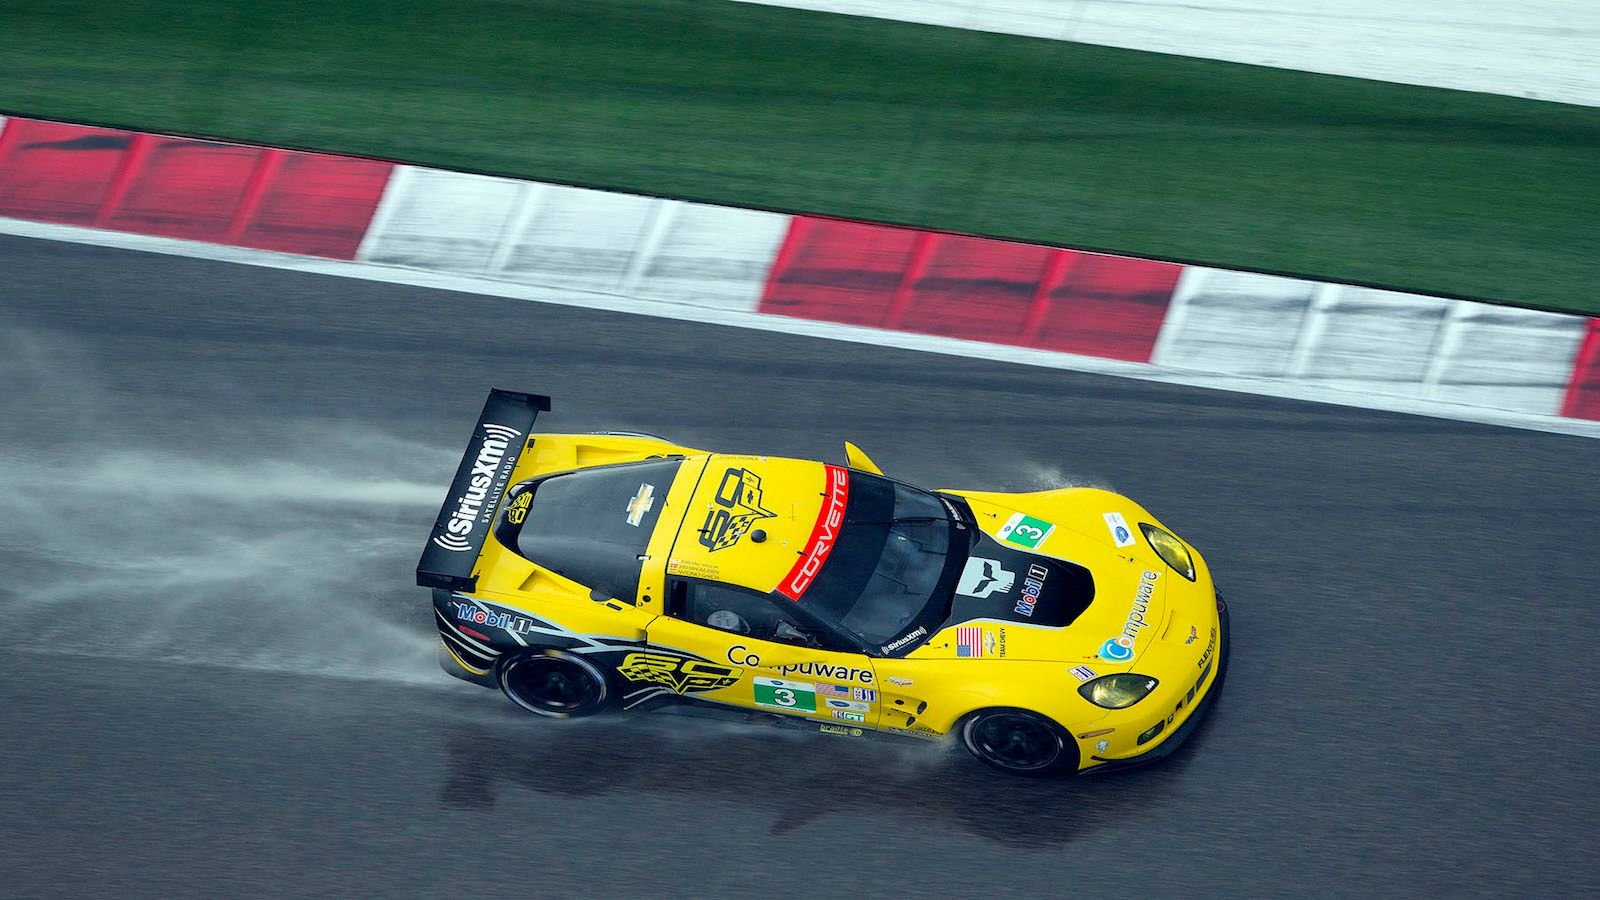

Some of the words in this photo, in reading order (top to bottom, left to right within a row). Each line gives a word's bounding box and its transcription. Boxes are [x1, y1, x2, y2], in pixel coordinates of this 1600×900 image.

[481, 482, 505, 523] SATELLITE
[500, 456, 516, 480] RADIO
[790, 468, 846, 594] CORVETTE
[1015, 524, 1044, 540] 3
[458, 603, 511, 629] Mobil
[1014, 577, 1043, 617] Mobil
[1106, 570, 1158, 660] Compuware
[727, 645, 873, 684] Copuware
[774, 688, 798, 707] 3
[844, 713, 865, 721] GT
